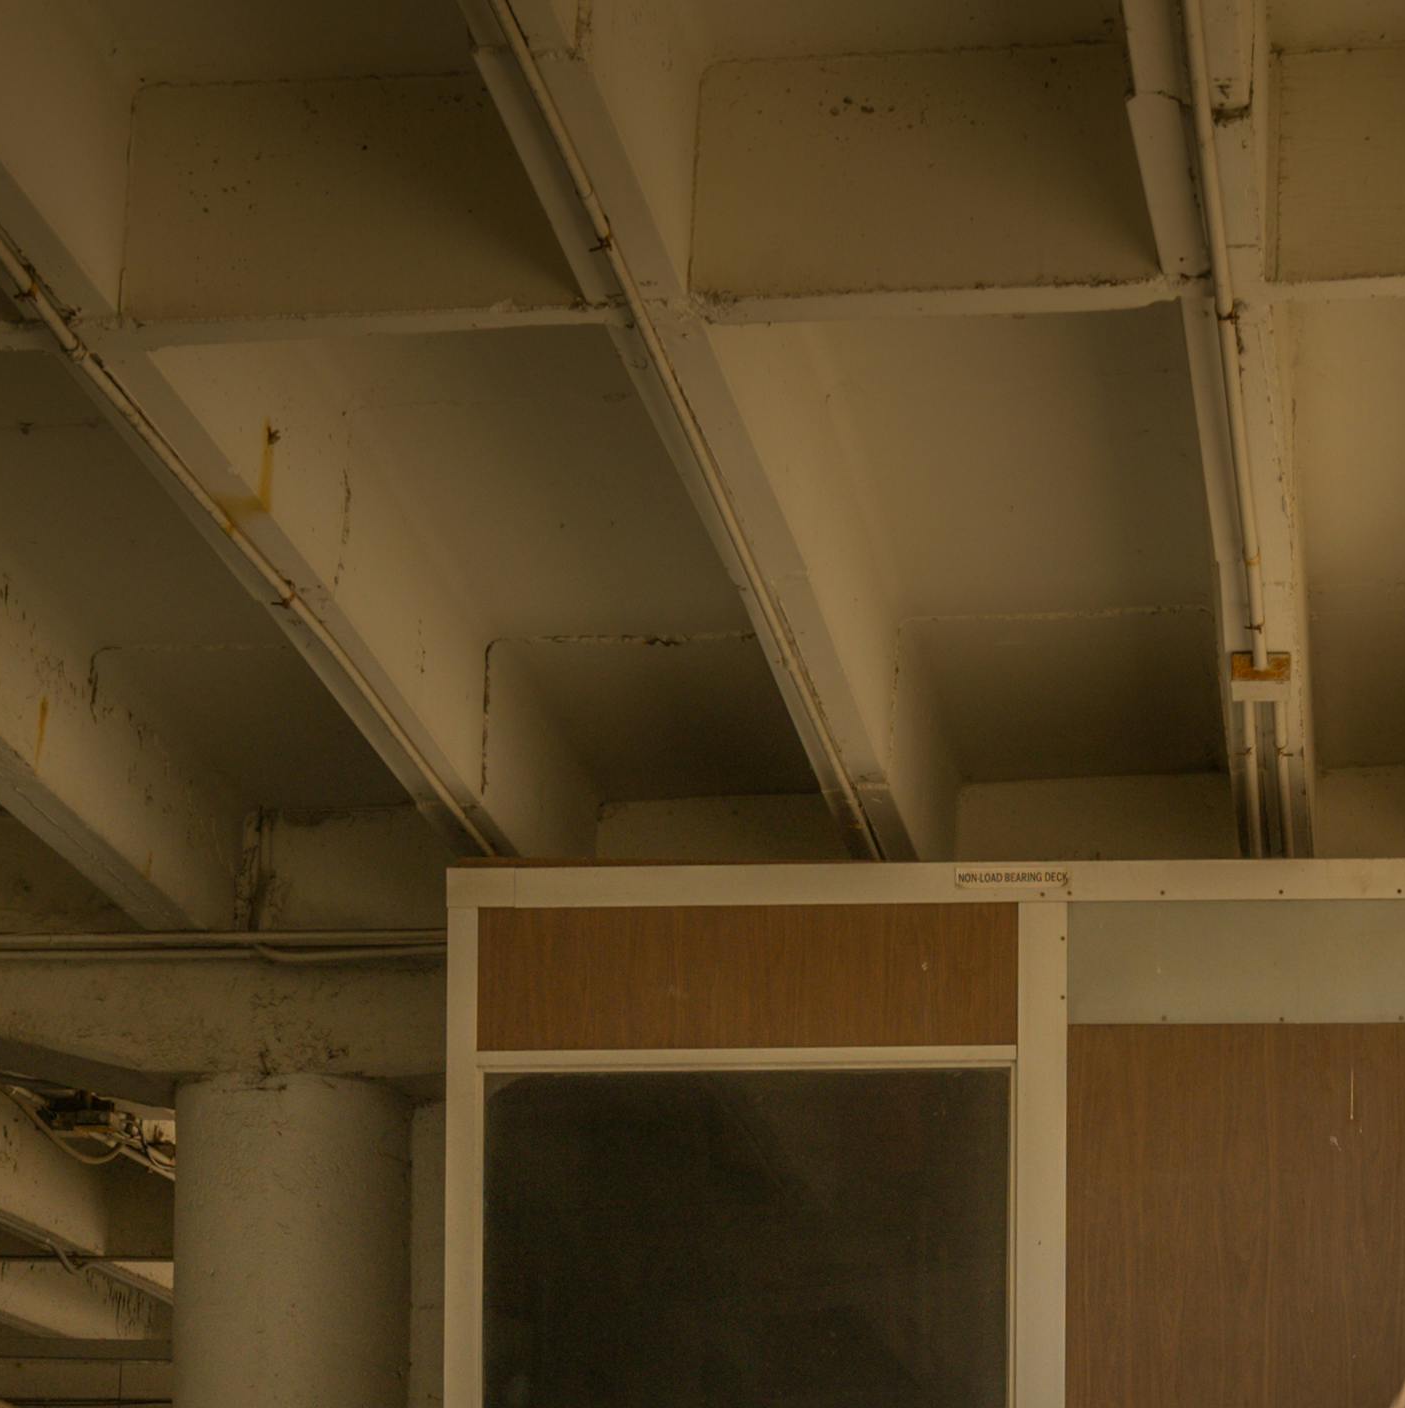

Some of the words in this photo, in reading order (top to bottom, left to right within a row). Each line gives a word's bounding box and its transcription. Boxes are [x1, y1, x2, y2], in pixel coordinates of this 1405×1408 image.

[958, 872, 978, 883] NON
[979, 872, 1003, 883] LOAD
[1004, 872, 1043, 882] BEARING
[1044, 871, 1068, 882] DECK
